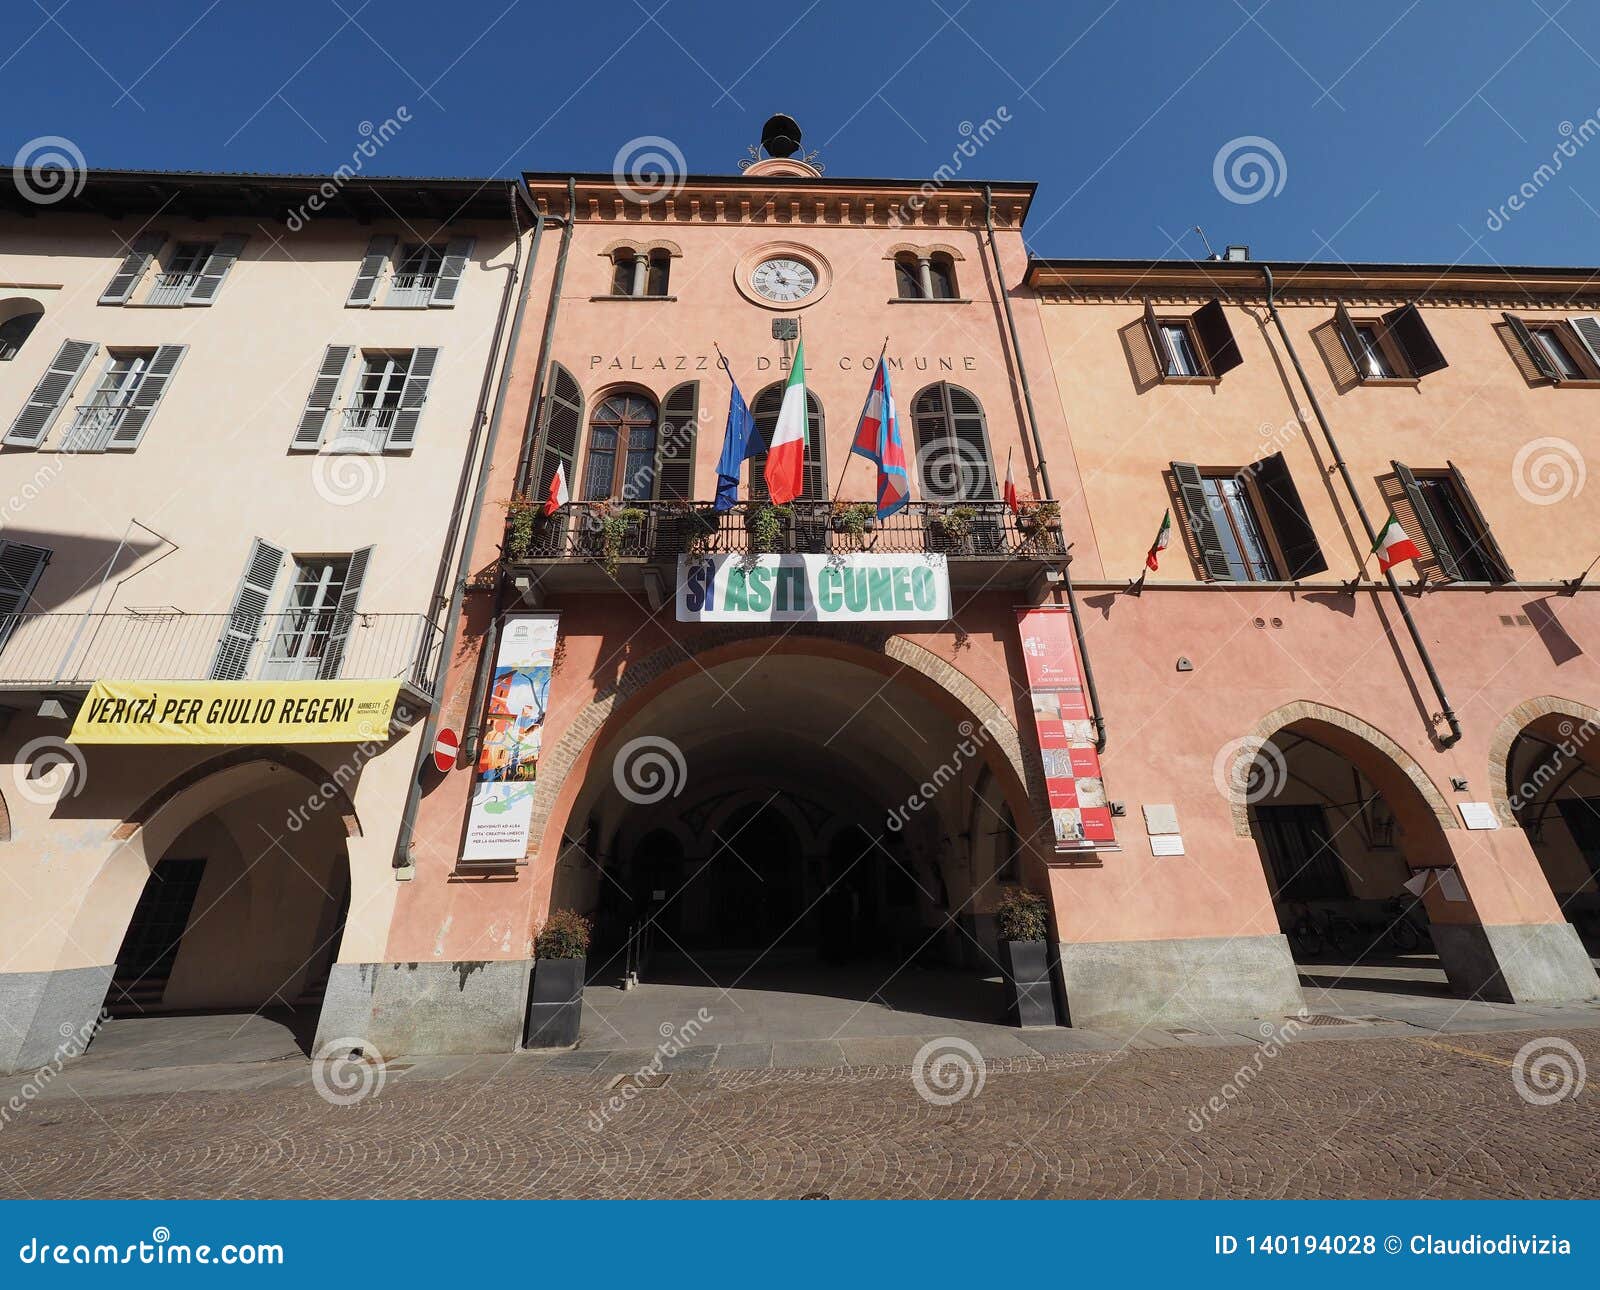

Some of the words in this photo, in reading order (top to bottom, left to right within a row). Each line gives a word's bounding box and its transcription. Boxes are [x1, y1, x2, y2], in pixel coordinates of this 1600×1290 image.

[590, 356, 730, 371] PALAZZO
[839, 356, 977, 371] COMUNE
[724, 566, 806, 613] ASTI
[817, 566, 937, 613] CUNEO
[87, 693, 157, 724] VERITÀ
[158, 698, 201, 724] PER
[206, 697, 275, 724] GIULIO
[278, 697, 354, 724] REGENI
